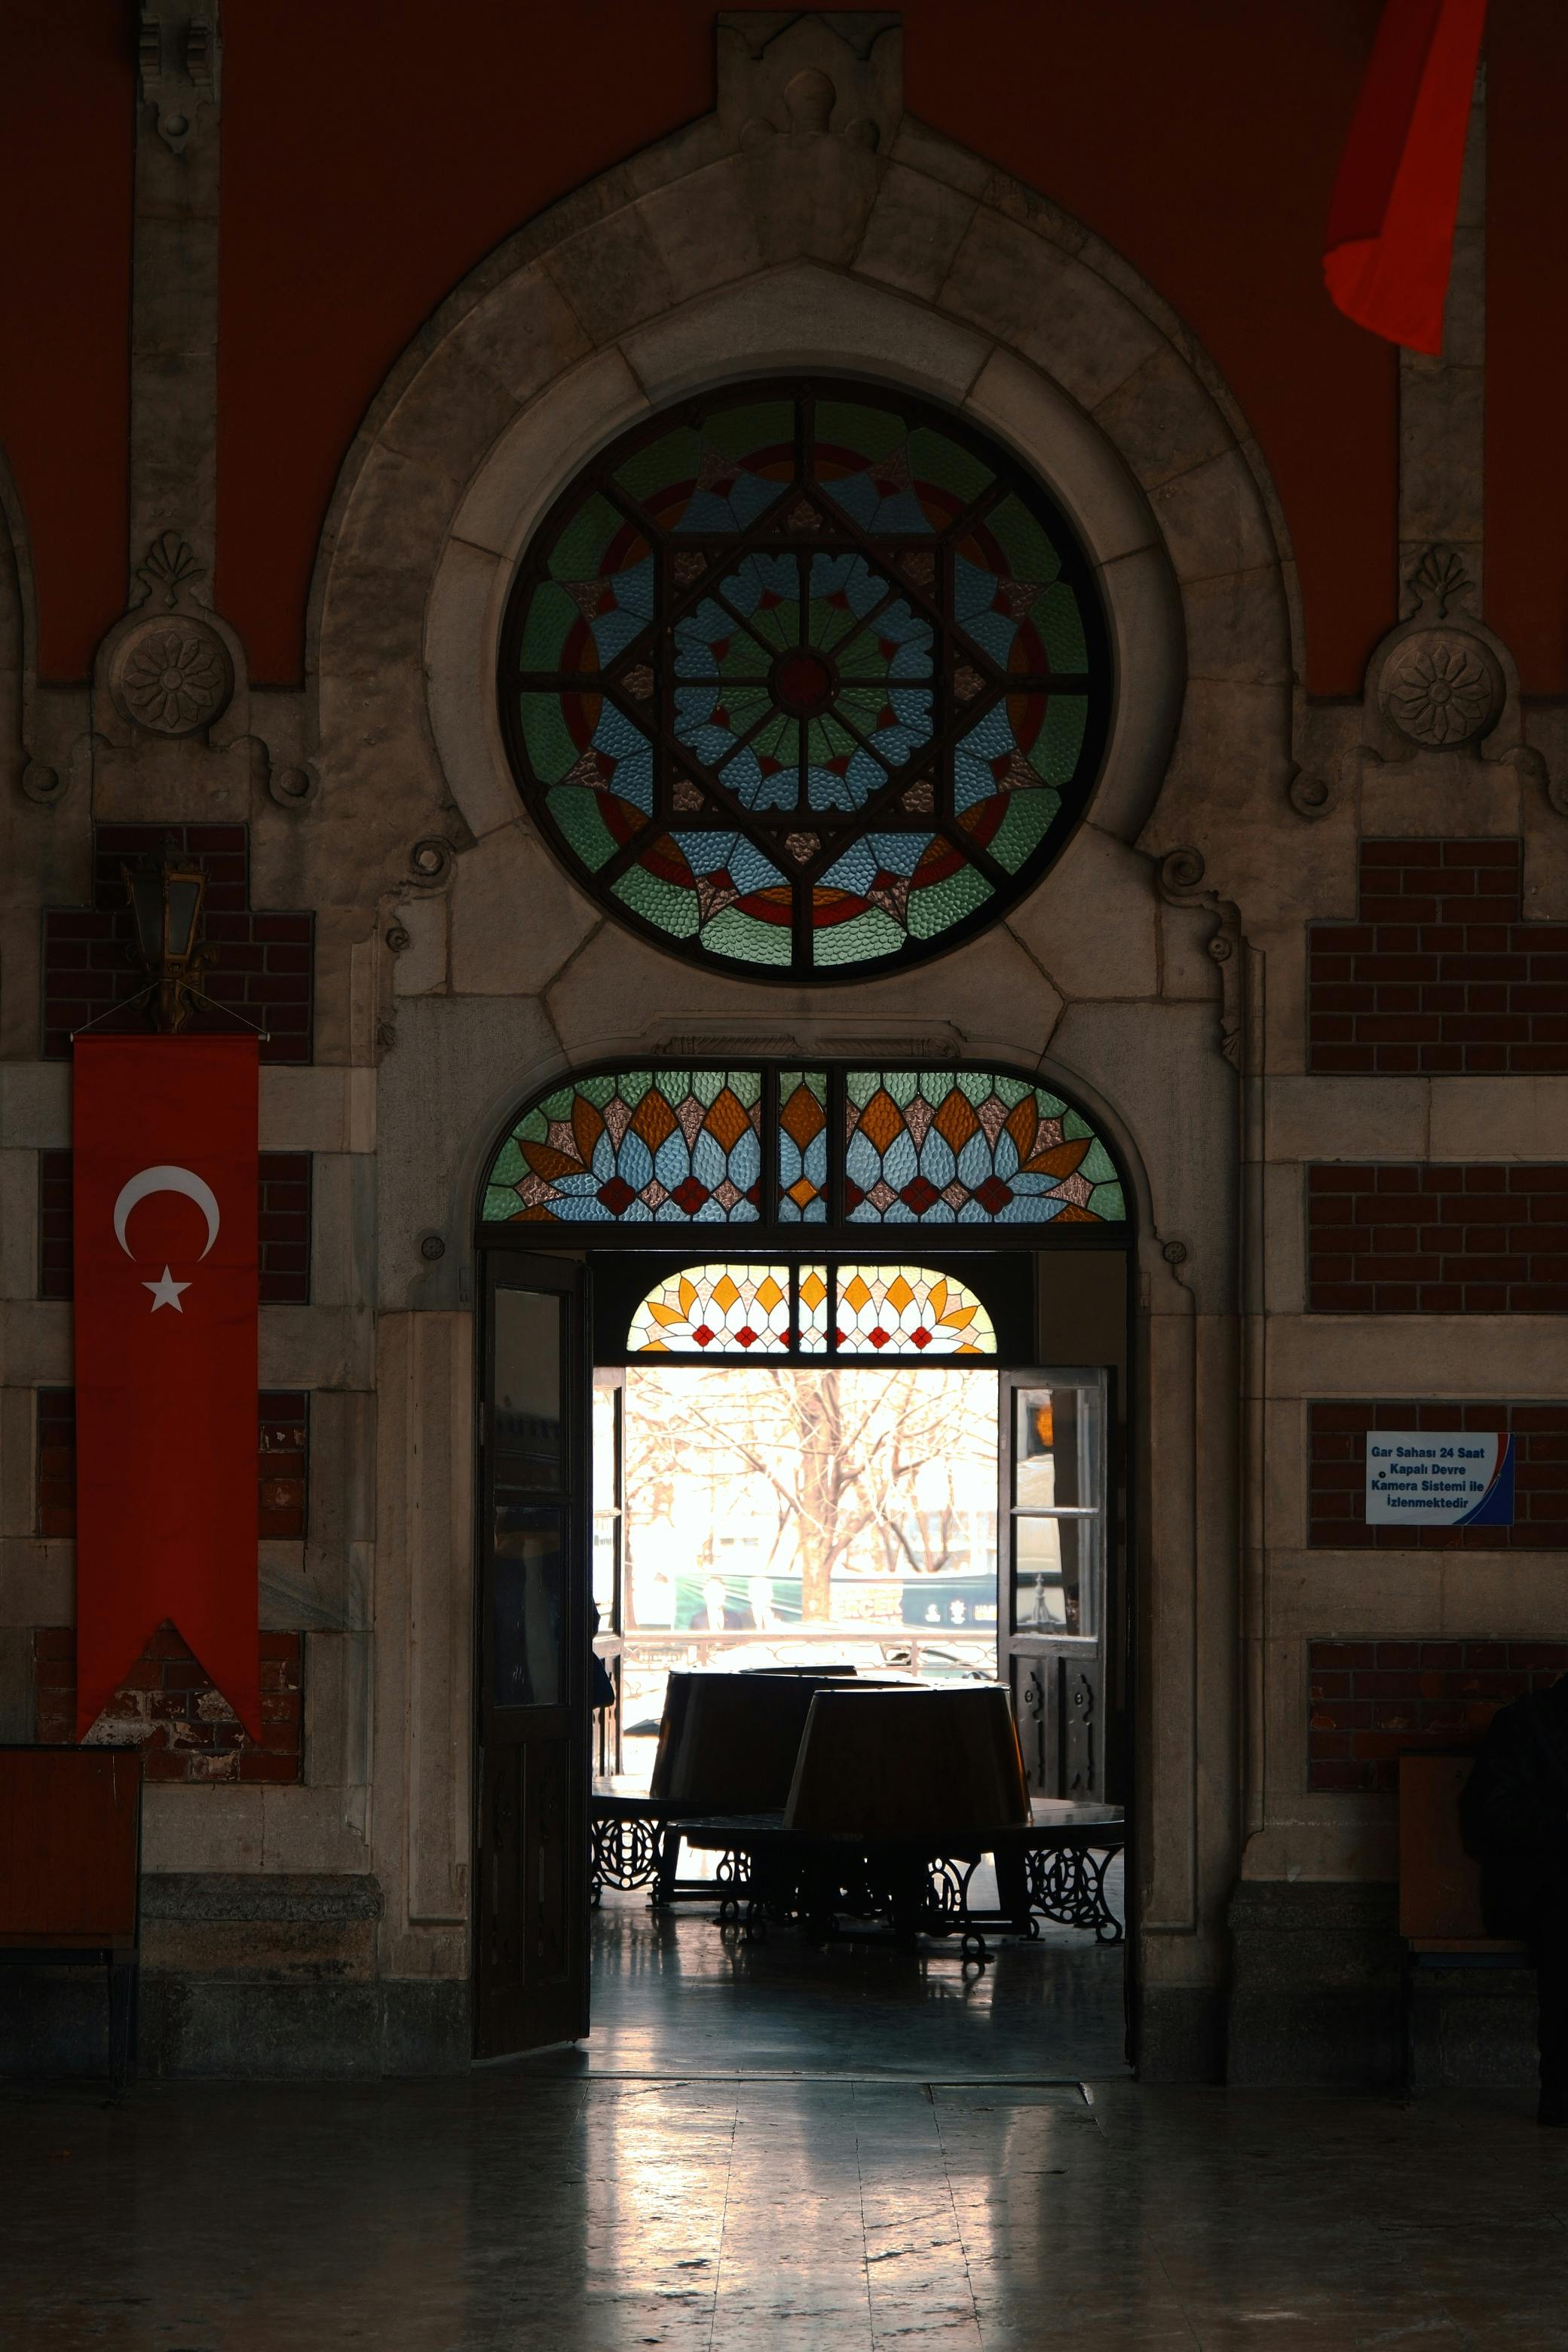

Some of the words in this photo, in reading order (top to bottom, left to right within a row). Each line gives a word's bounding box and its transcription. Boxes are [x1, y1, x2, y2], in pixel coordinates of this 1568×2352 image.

[1371, 1446, 1393, 1457] Gar
[1396, 1447, 1436, 1458] Sahası
[1440, 1447, 1454, 1458] 24
[1458, 1447, 1484, 1459] Saat
[1390, 1463, 1428, 1476] Kapalı
[1432, 1464, 1466, 1475] Devre
[1371, 1480, 1417, 1490] Kamera
[1422, 1481, 1466, 1491] Sistemi
[1469, 1481, 1484, 1492] ile
[1387, 1494, 1468, 1508] İzlenmektedir
